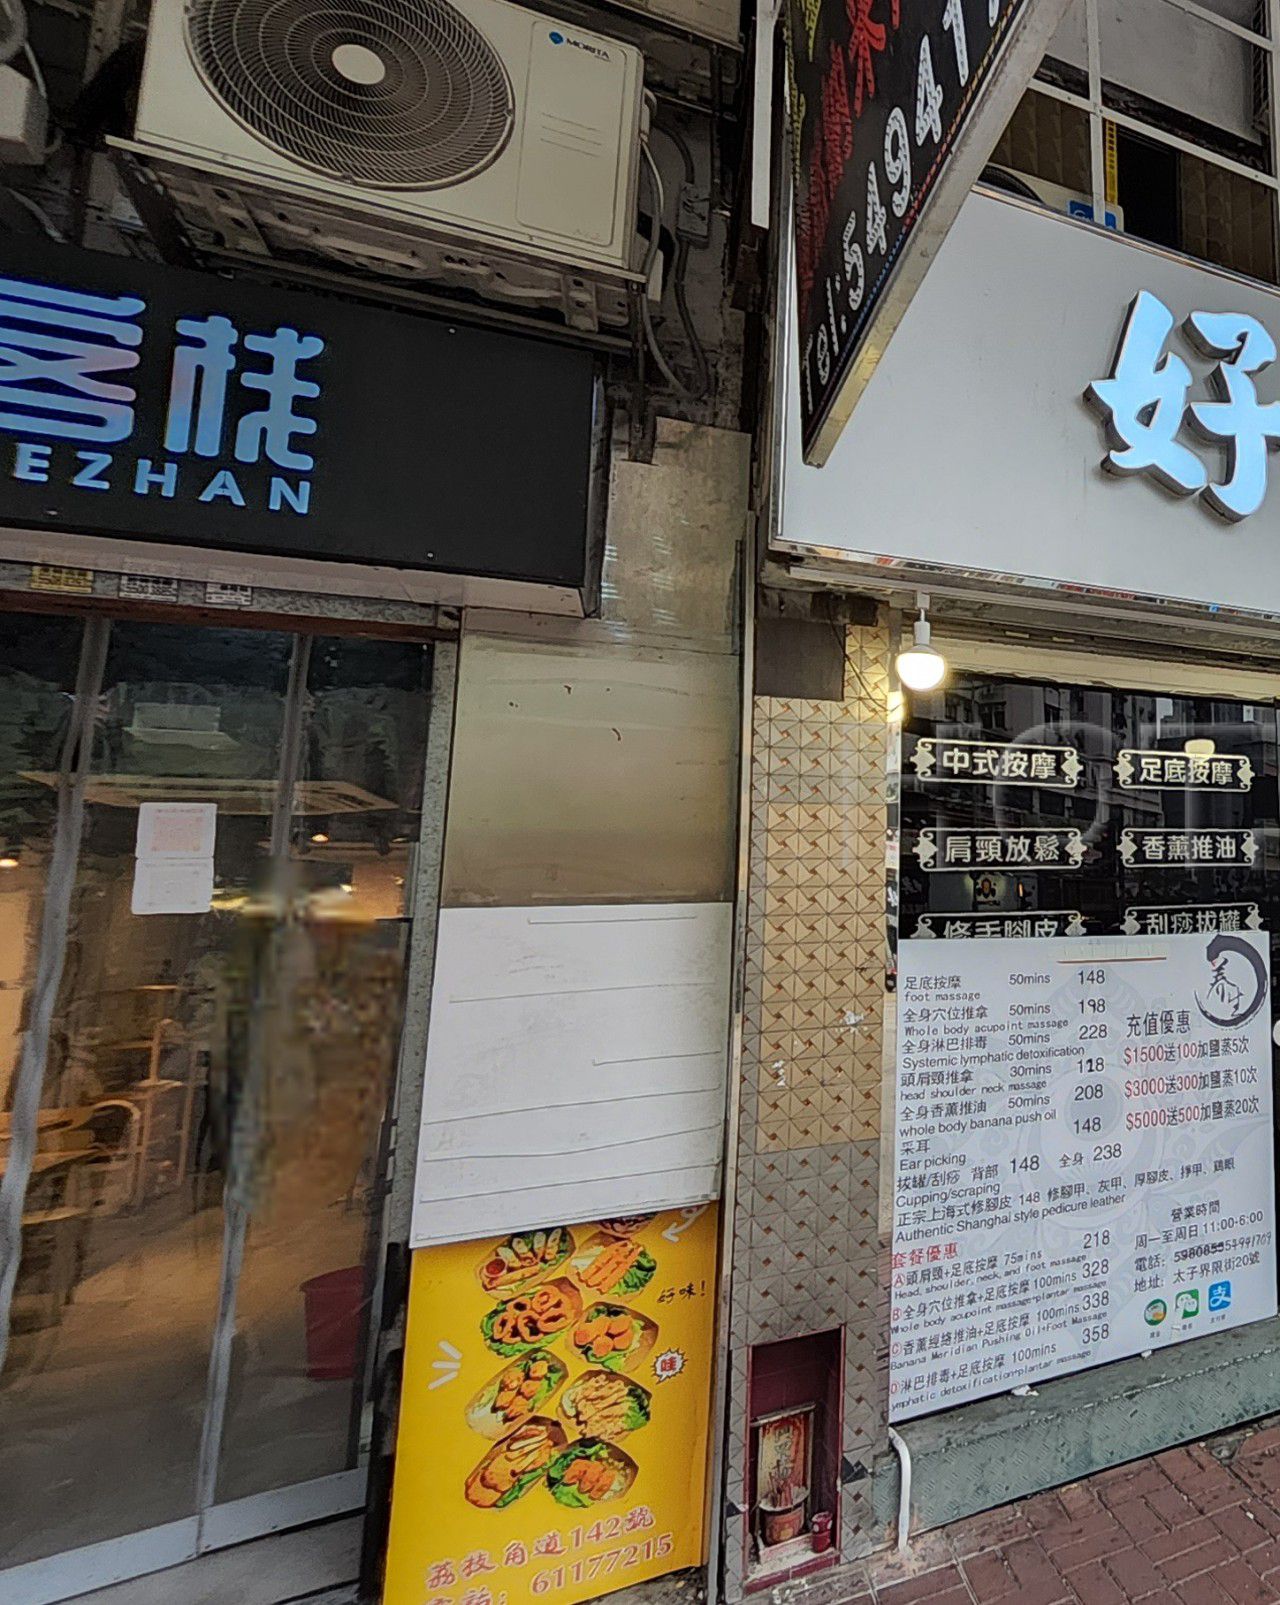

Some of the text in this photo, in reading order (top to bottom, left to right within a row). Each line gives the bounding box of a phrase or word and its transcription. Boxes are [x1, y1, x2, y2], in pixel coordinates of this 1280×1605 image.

[943, 747, 1057, 780] 中式按摩
[1140, 757, 1233, 787] 足底按摩
[944, 835, 1060, 863] 肩頸放鬆
[1141, 835, 1237, 861] 香薰推油
[1146, 909, 1241, 935] 刮痧拔罐
[903, 969, 1106, 991] 足底按摩 50mins 148
[904, 990, 981, 1002] foot massage
[1009, 1001, 1050, 1016] 50mins
[1078, 997, 1106, 1014] 198
[904, 1018, 1068, 1038] Whole body acupoint massage
[1126, 1009, 1191, 1038] 充值優惠
[902, 1023, 1107, 1055] 全身淋巴排毒 50mins 228
[902, 1044, 1085, 1071] Systemic lymphatic detoxification
[1009, 1062, 1052, 1078] 30mins
[900, 1079, 1047, 1102] head shoulder neck massage
[1008, 1093, 1050, 1109] 50mins
[1074, 1083, 1103, 1101] 208
[899, 1108, 1056, 1138] whole body banana push oil
[1073, 1116, 1101, 1134] 148
[899, 1151, 966, 1170] Ear picking
[971, 1163, 998, 1181] 背部
[1010, 1155, 1039, 1174] 148
[1059, 1151, 1083, 1168] 全身
[1093, 1143, 1121, 1161] 238
[895, 1180, 1000, 1210] Cupping/scraping
[1019, 1191, 1040, 1206] 148
[895, 1192, 1125, 1243] Authentic Shanghai style pedicure leather
[1170, 1199, 1220, 1223] 營業時間
[1083, 1229, 1110, 1250] 218
[1004, 1266, 1020, 1278] and
[1025, 1260, 1045, 1273] foot
[1082, 1258, 1109, 1279] 328
[1082, 1289, 1109, 1311] 338
[1082, 1322, 1109, 1345] 358
[890, 1353, 926, 1372] Banana
[981, 1330, 1020, 1350] Pushing
[426, 1507, 653, 1589] 荔枝角道142號
[532, 1534, 672, 1594] 61177215
